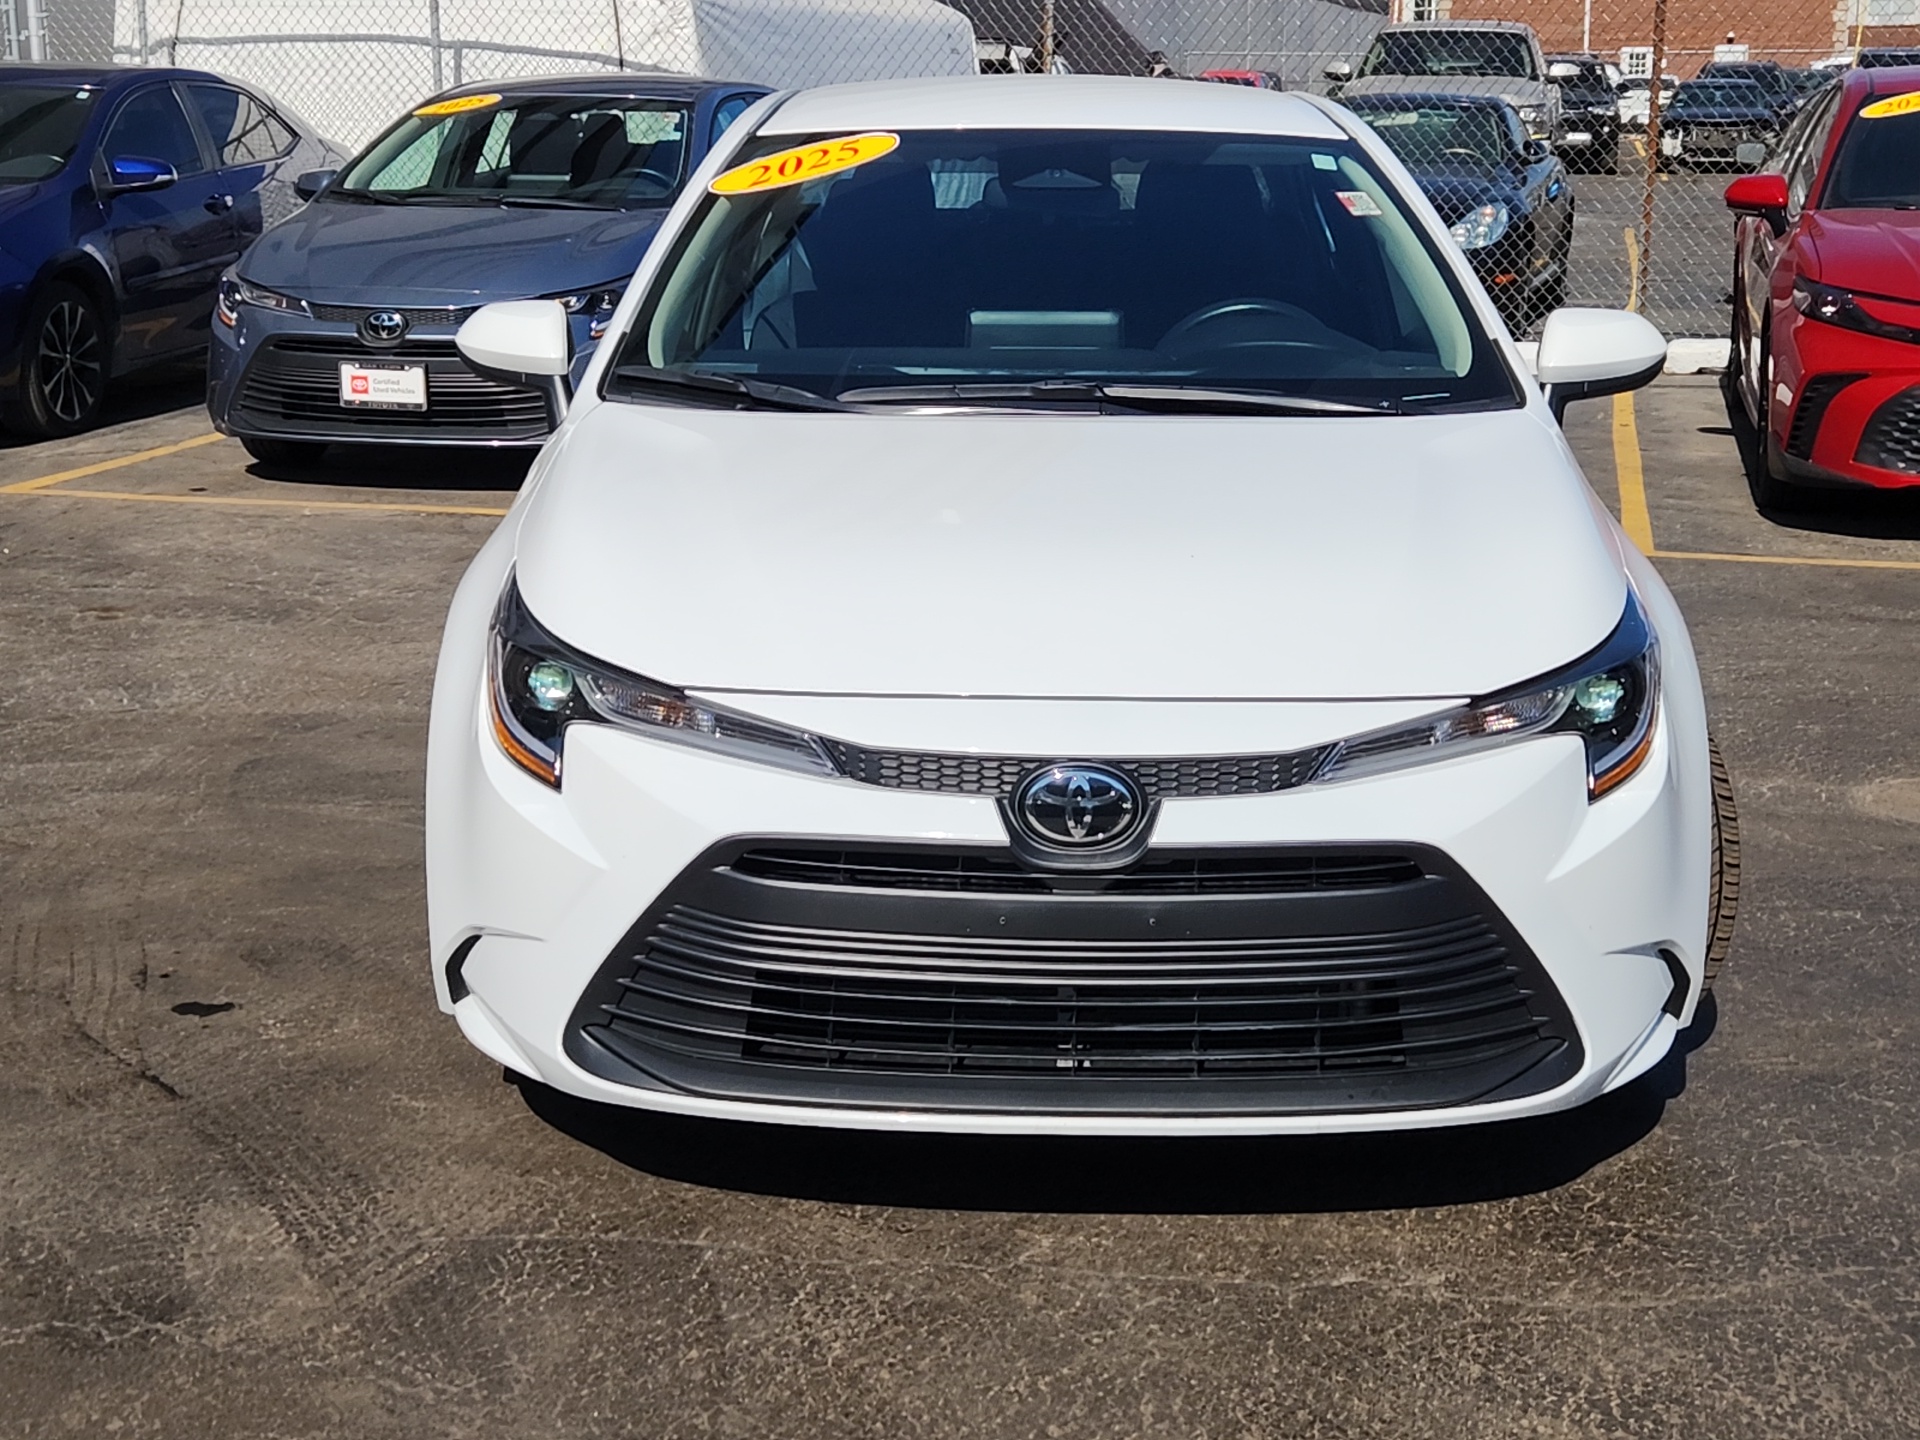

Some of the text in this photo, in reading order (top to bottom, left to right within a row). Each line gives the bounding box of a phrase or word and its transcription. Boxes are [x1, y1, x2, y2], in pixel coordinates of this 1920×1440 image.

[748, 139, 860, 187] 2025
[373, 378, 400, 386] Certified
[390, 387, 416, 395] Vehicles
